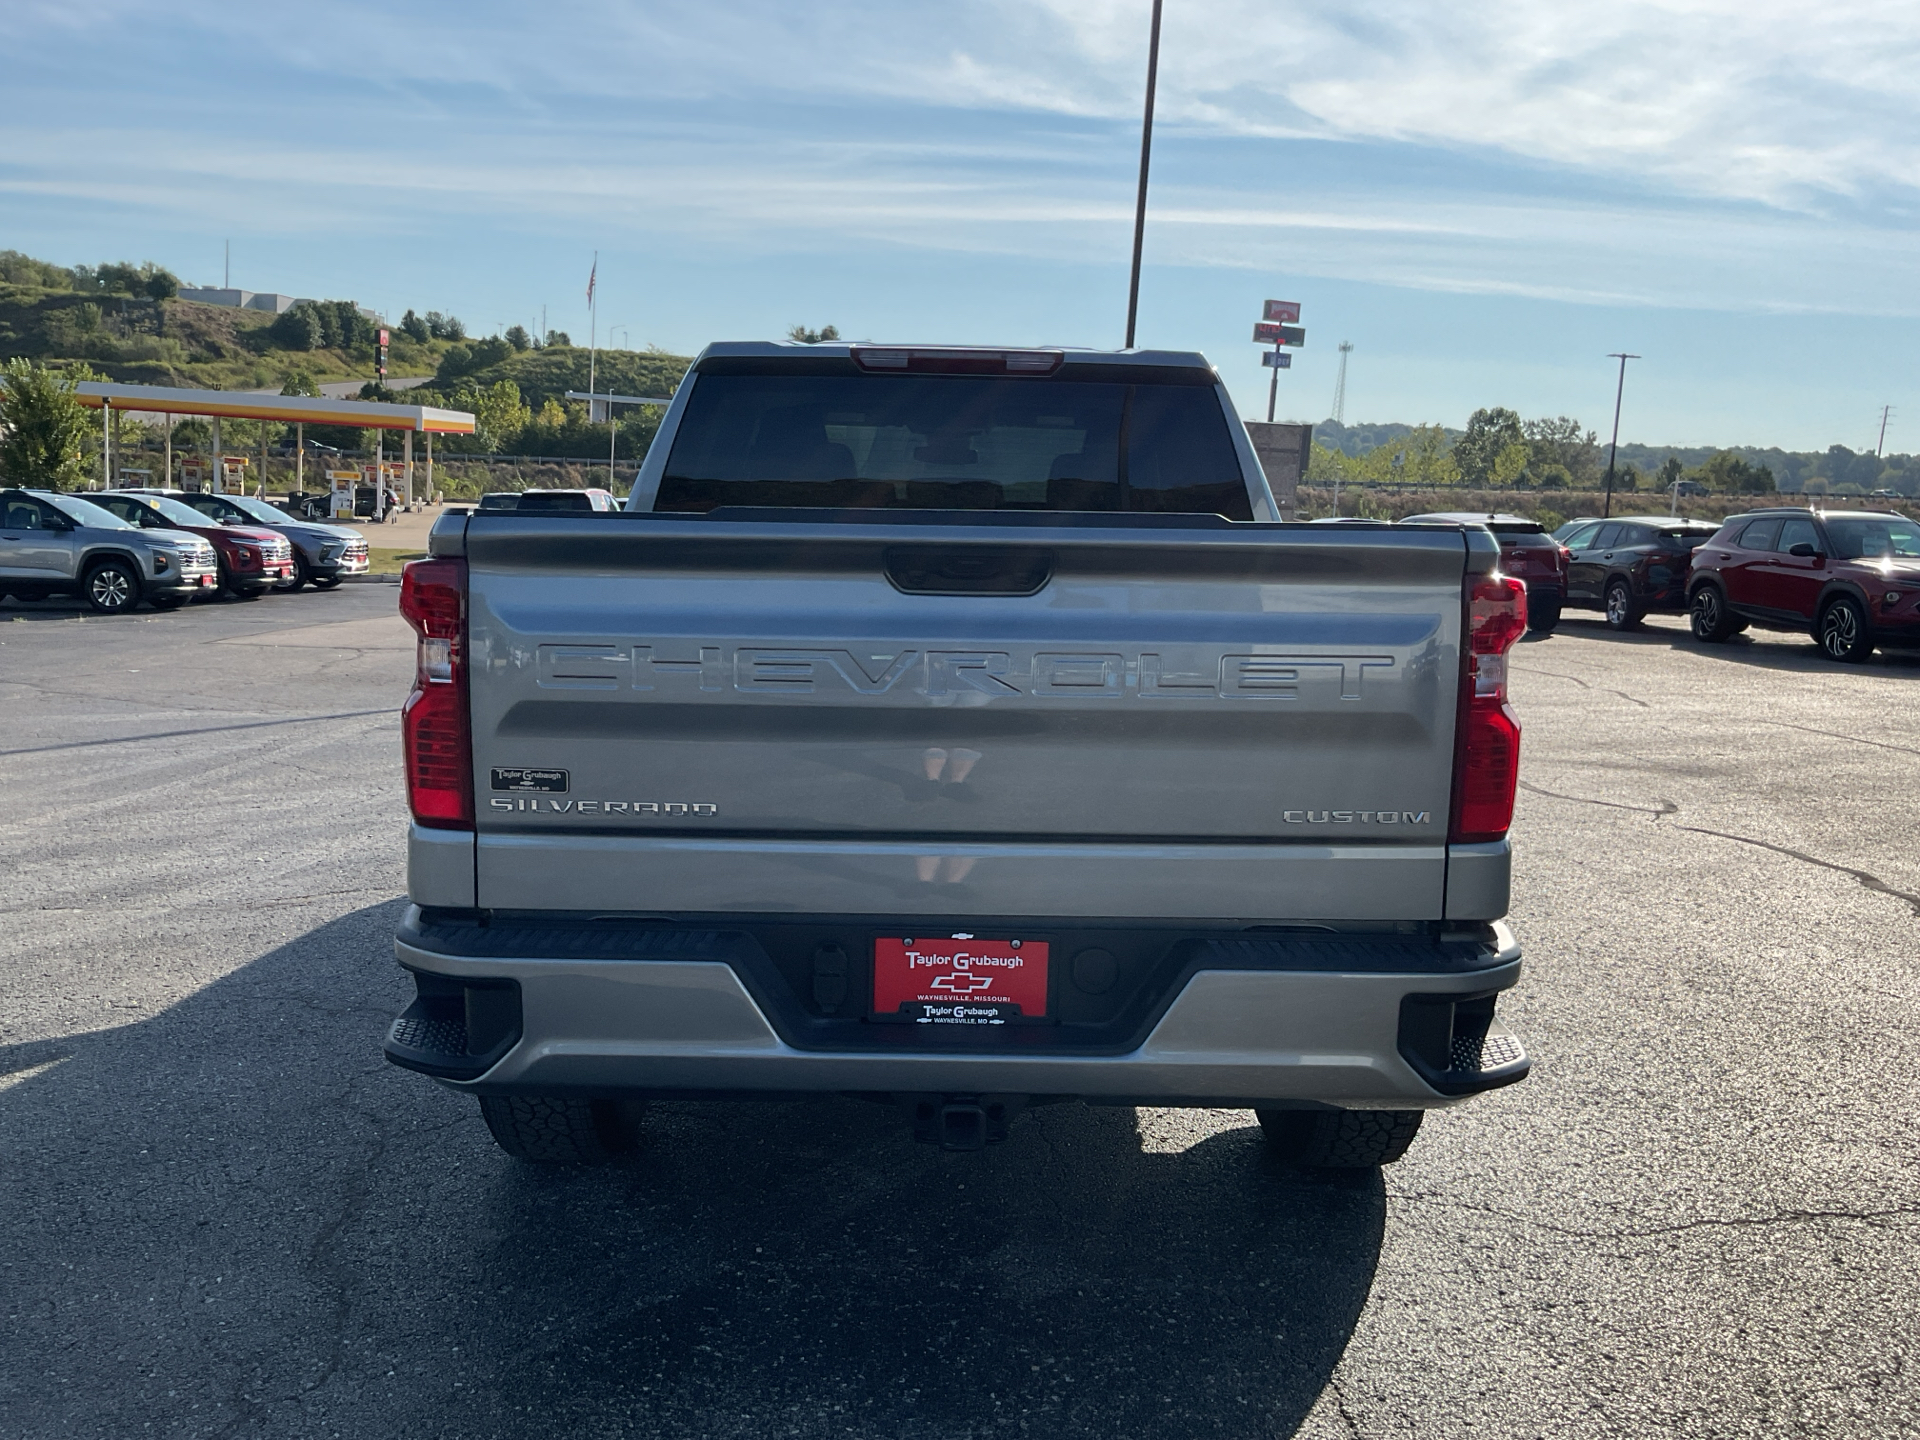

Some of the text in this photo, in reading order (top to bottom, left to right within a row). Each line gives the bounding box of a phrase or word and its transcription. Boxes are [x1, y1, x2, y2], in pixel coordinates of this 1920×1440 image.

[537, 643, 1395, 700] CHEVROLET
[496, 769, 561, 780] Taylor Grubaugh
[490, 798, 717, 816] SILVERADO
[1283, 810, 1430, 824] CUSTOM
[905, 951, 1024, 970] Taylor Grubaugh
[917, 994, 972, 1002] WAYNESVILLE,
[923, 1005, 998, 1018] Taylor Grubaugh
[933, 1017, 977, 1025] WAYNESVILLE,
